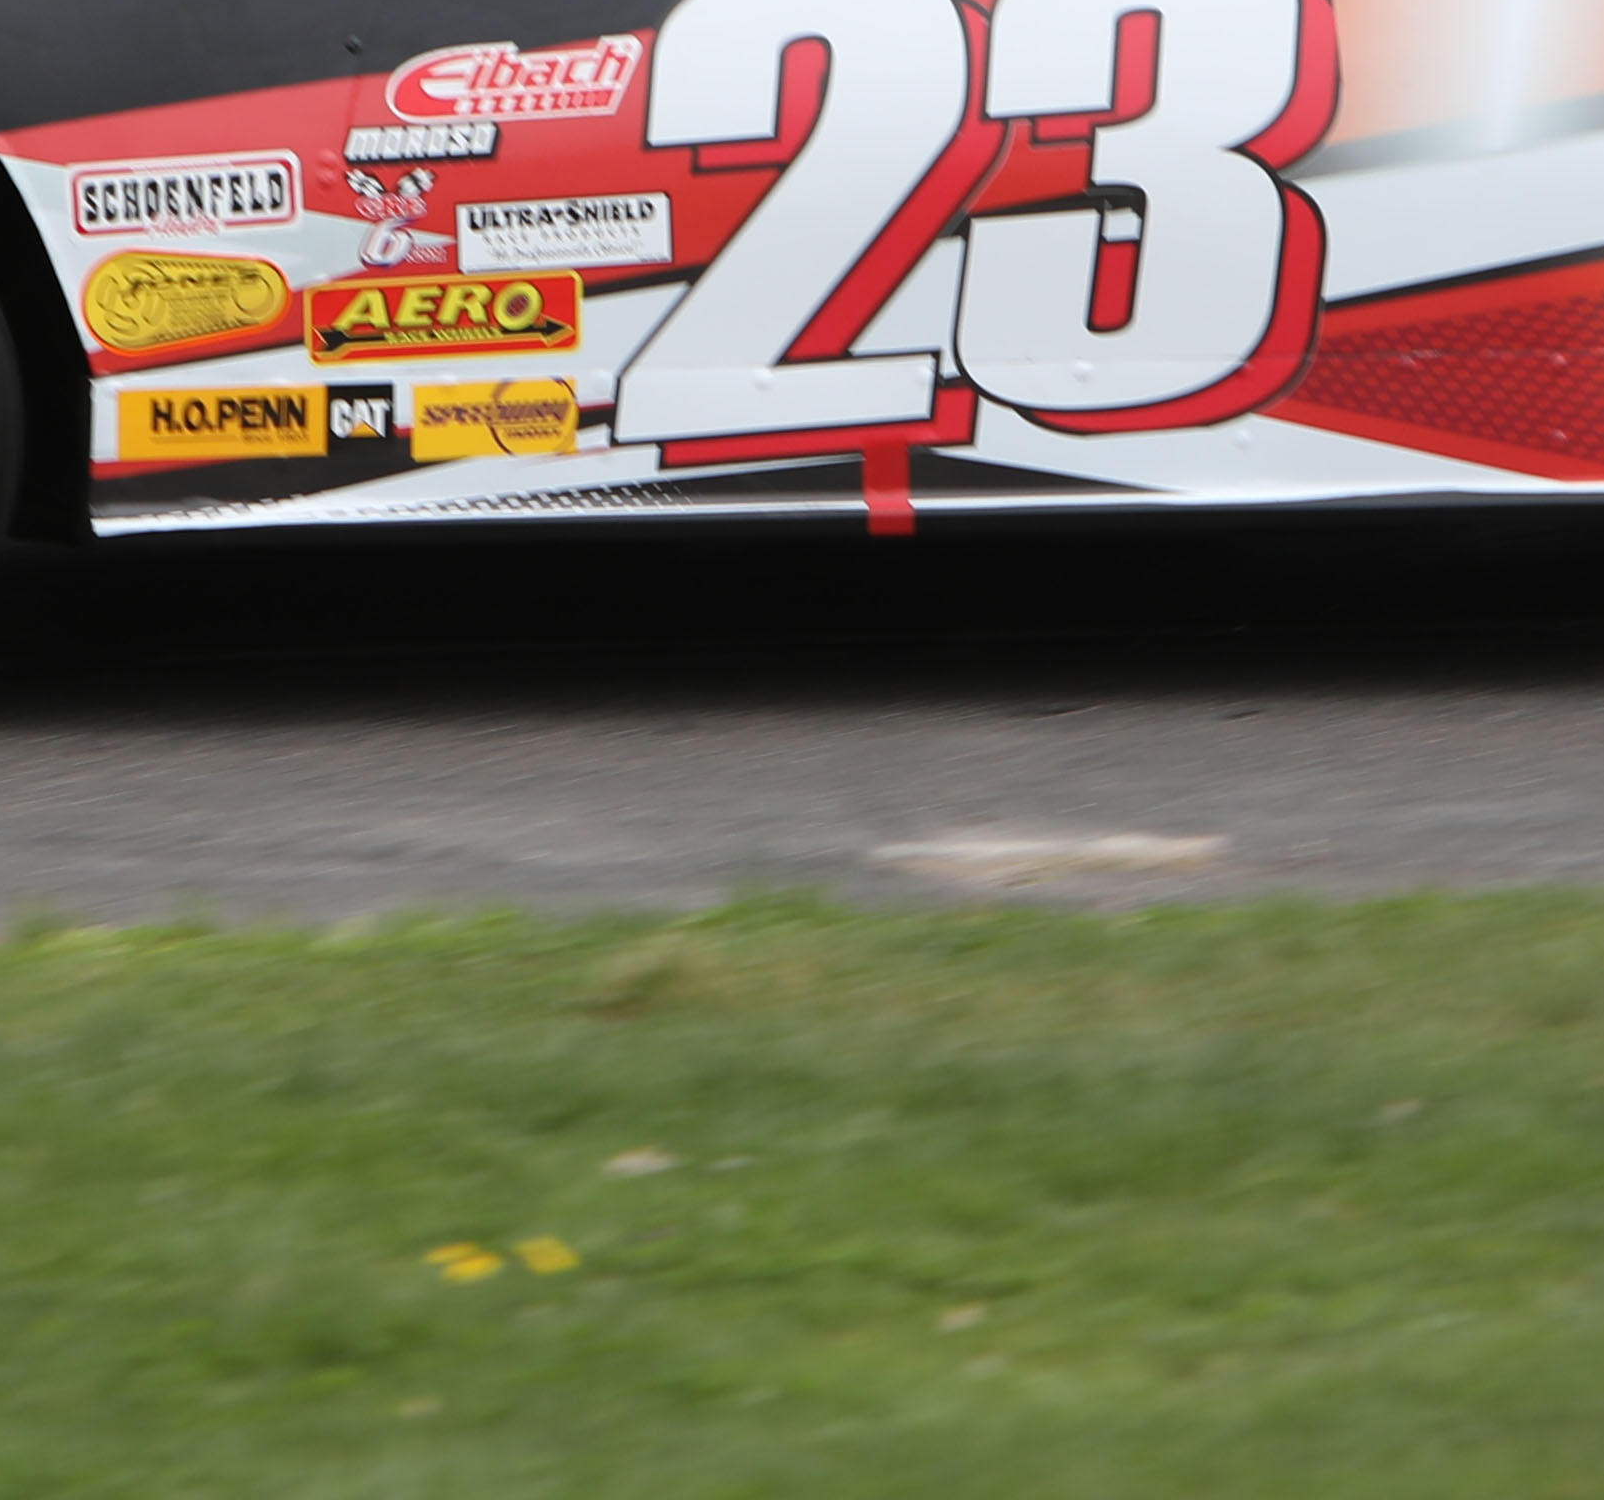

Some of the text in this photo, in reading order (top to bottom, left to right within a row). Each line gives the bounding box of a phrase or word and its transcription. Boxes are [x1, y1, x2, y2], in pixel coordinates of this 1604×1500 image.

[394, 45, 633, 118] Eibach
[84, 170, 284, 224] SCHOENFELD
[331, 282, 543, 331] AERO
[329, 397, 390, 439] CAT
